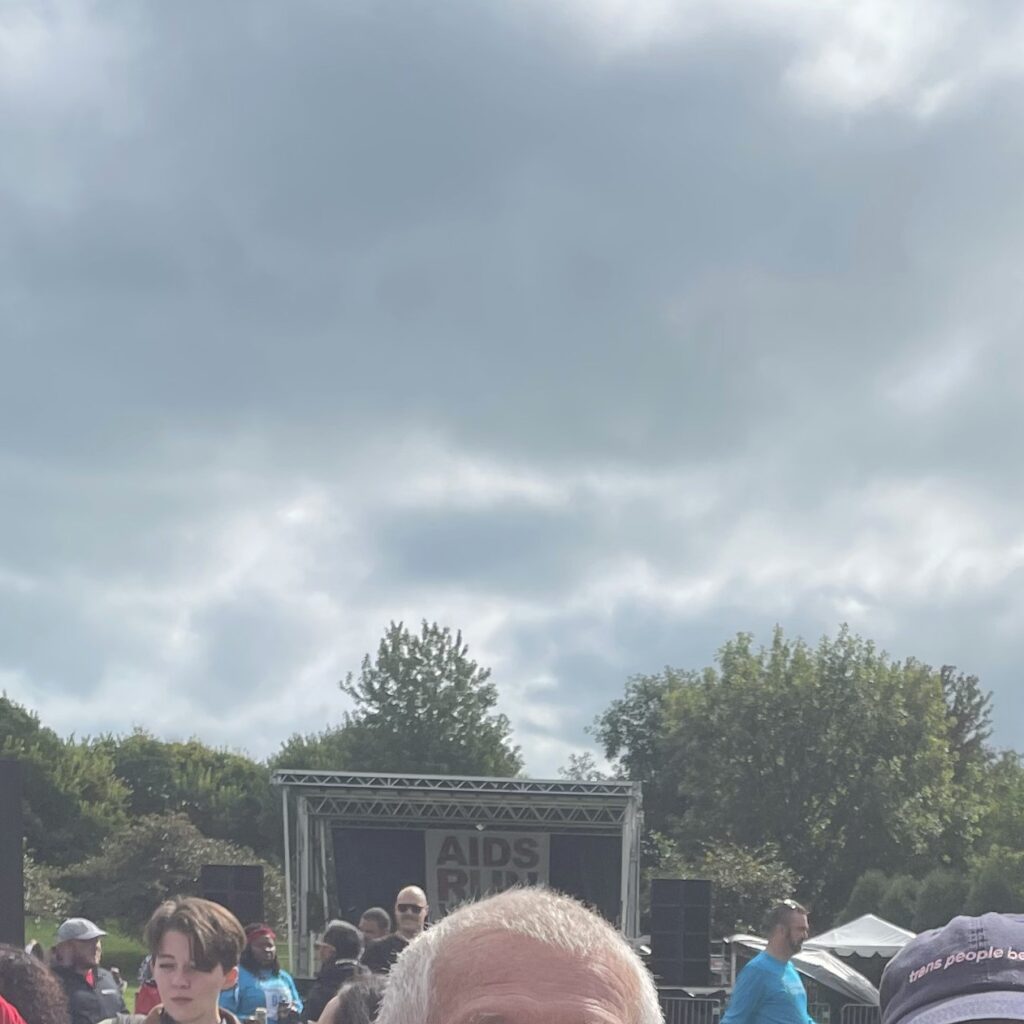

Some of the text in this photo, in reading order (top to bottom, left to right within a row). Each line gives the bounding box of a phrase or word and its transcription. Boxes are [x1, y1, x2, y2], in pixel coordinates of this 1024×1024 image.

[436, 835, 540, 869] AIDS
[908, 958, 943, 984] trans
[943, 946, 1004, 970] people
